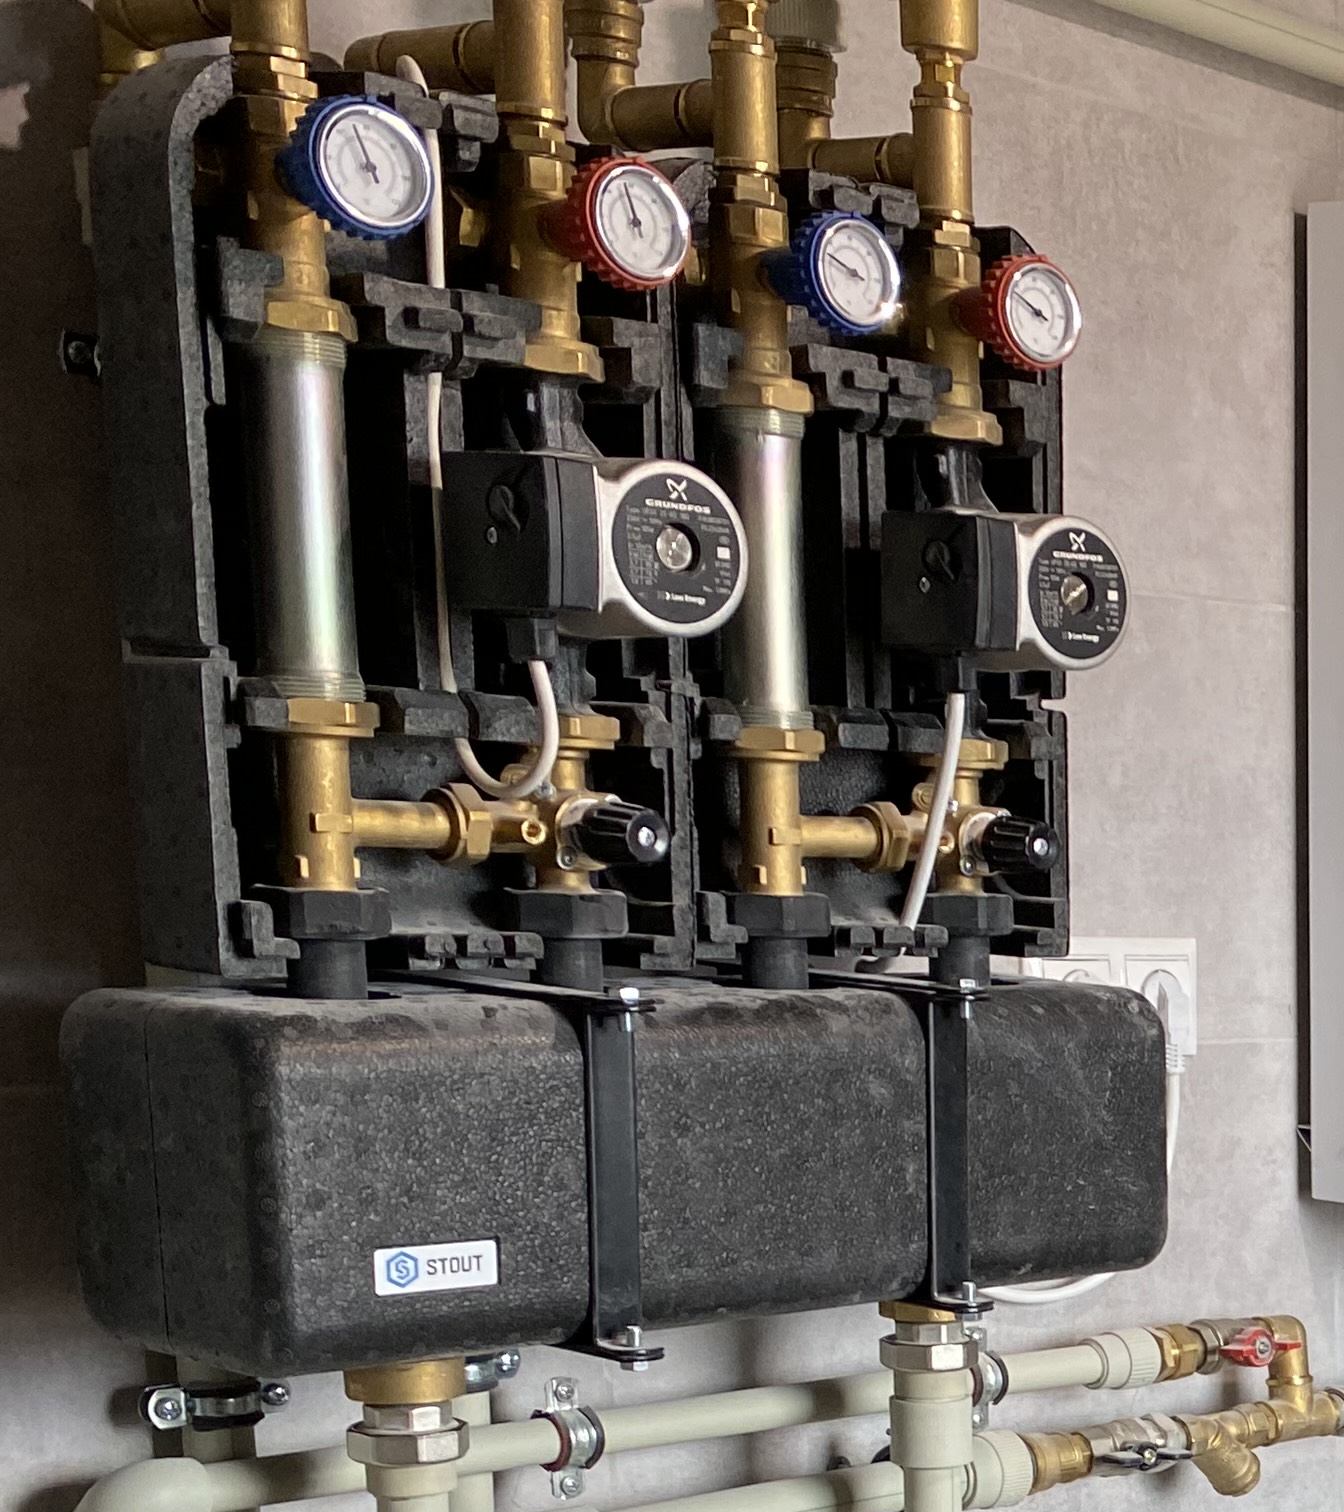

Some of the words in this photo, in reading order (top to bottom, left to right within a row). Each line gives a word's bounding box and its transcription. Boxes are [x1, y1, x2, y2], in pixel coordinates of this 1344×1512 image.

[645, 498, 711, 514] GRUNDFOS
[1052, 550, 1103, 562] GRUNDFOS
[426, 1255, 483, 1275] STOUT
